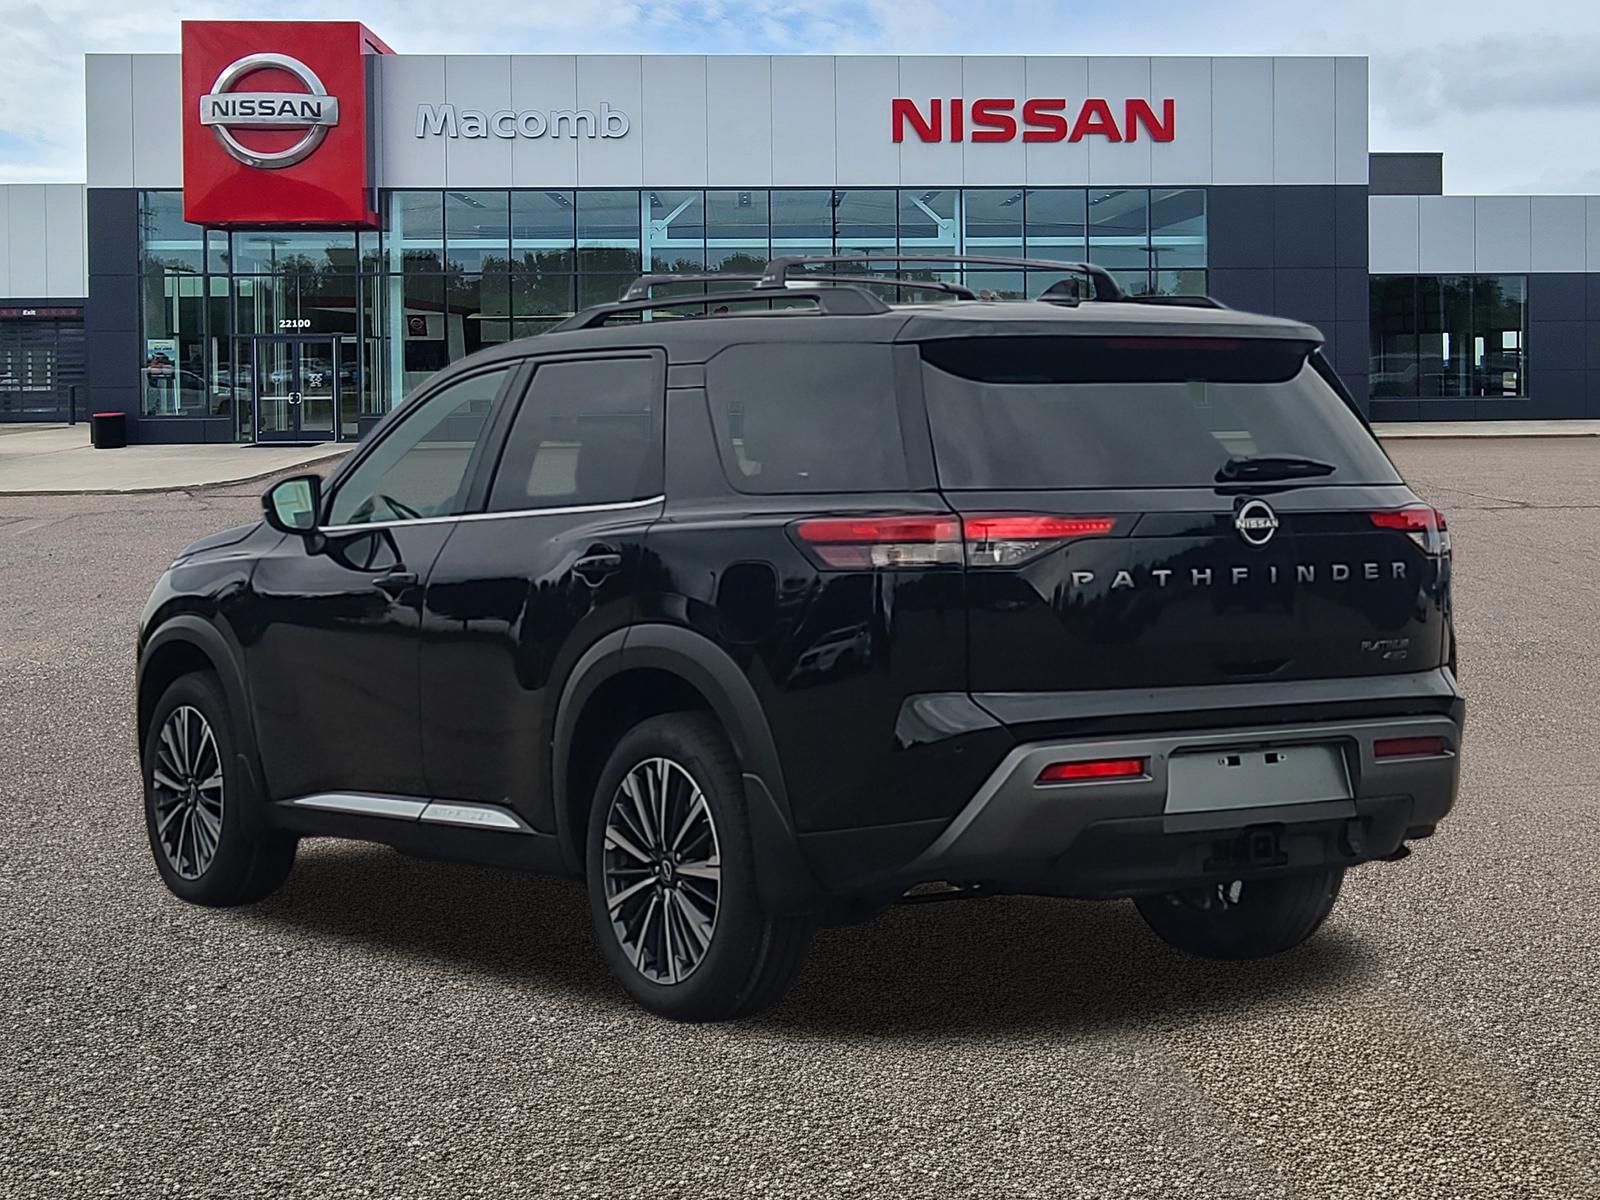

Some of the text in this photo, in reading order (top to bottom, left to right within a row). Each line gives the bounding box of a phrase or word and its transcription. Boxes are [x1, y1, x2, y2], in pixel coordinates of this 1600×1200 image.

[211, 100, 322, 117] NISSAN
[415, 102, 630, 139] Macomb
[892, 98, 1175, 143] NISSAN
[279, 319, 311, 328] 22100
[1235, 518, 1279, 529] NISSAN
[1072, 562, 1407, 588] PATHFINDER
